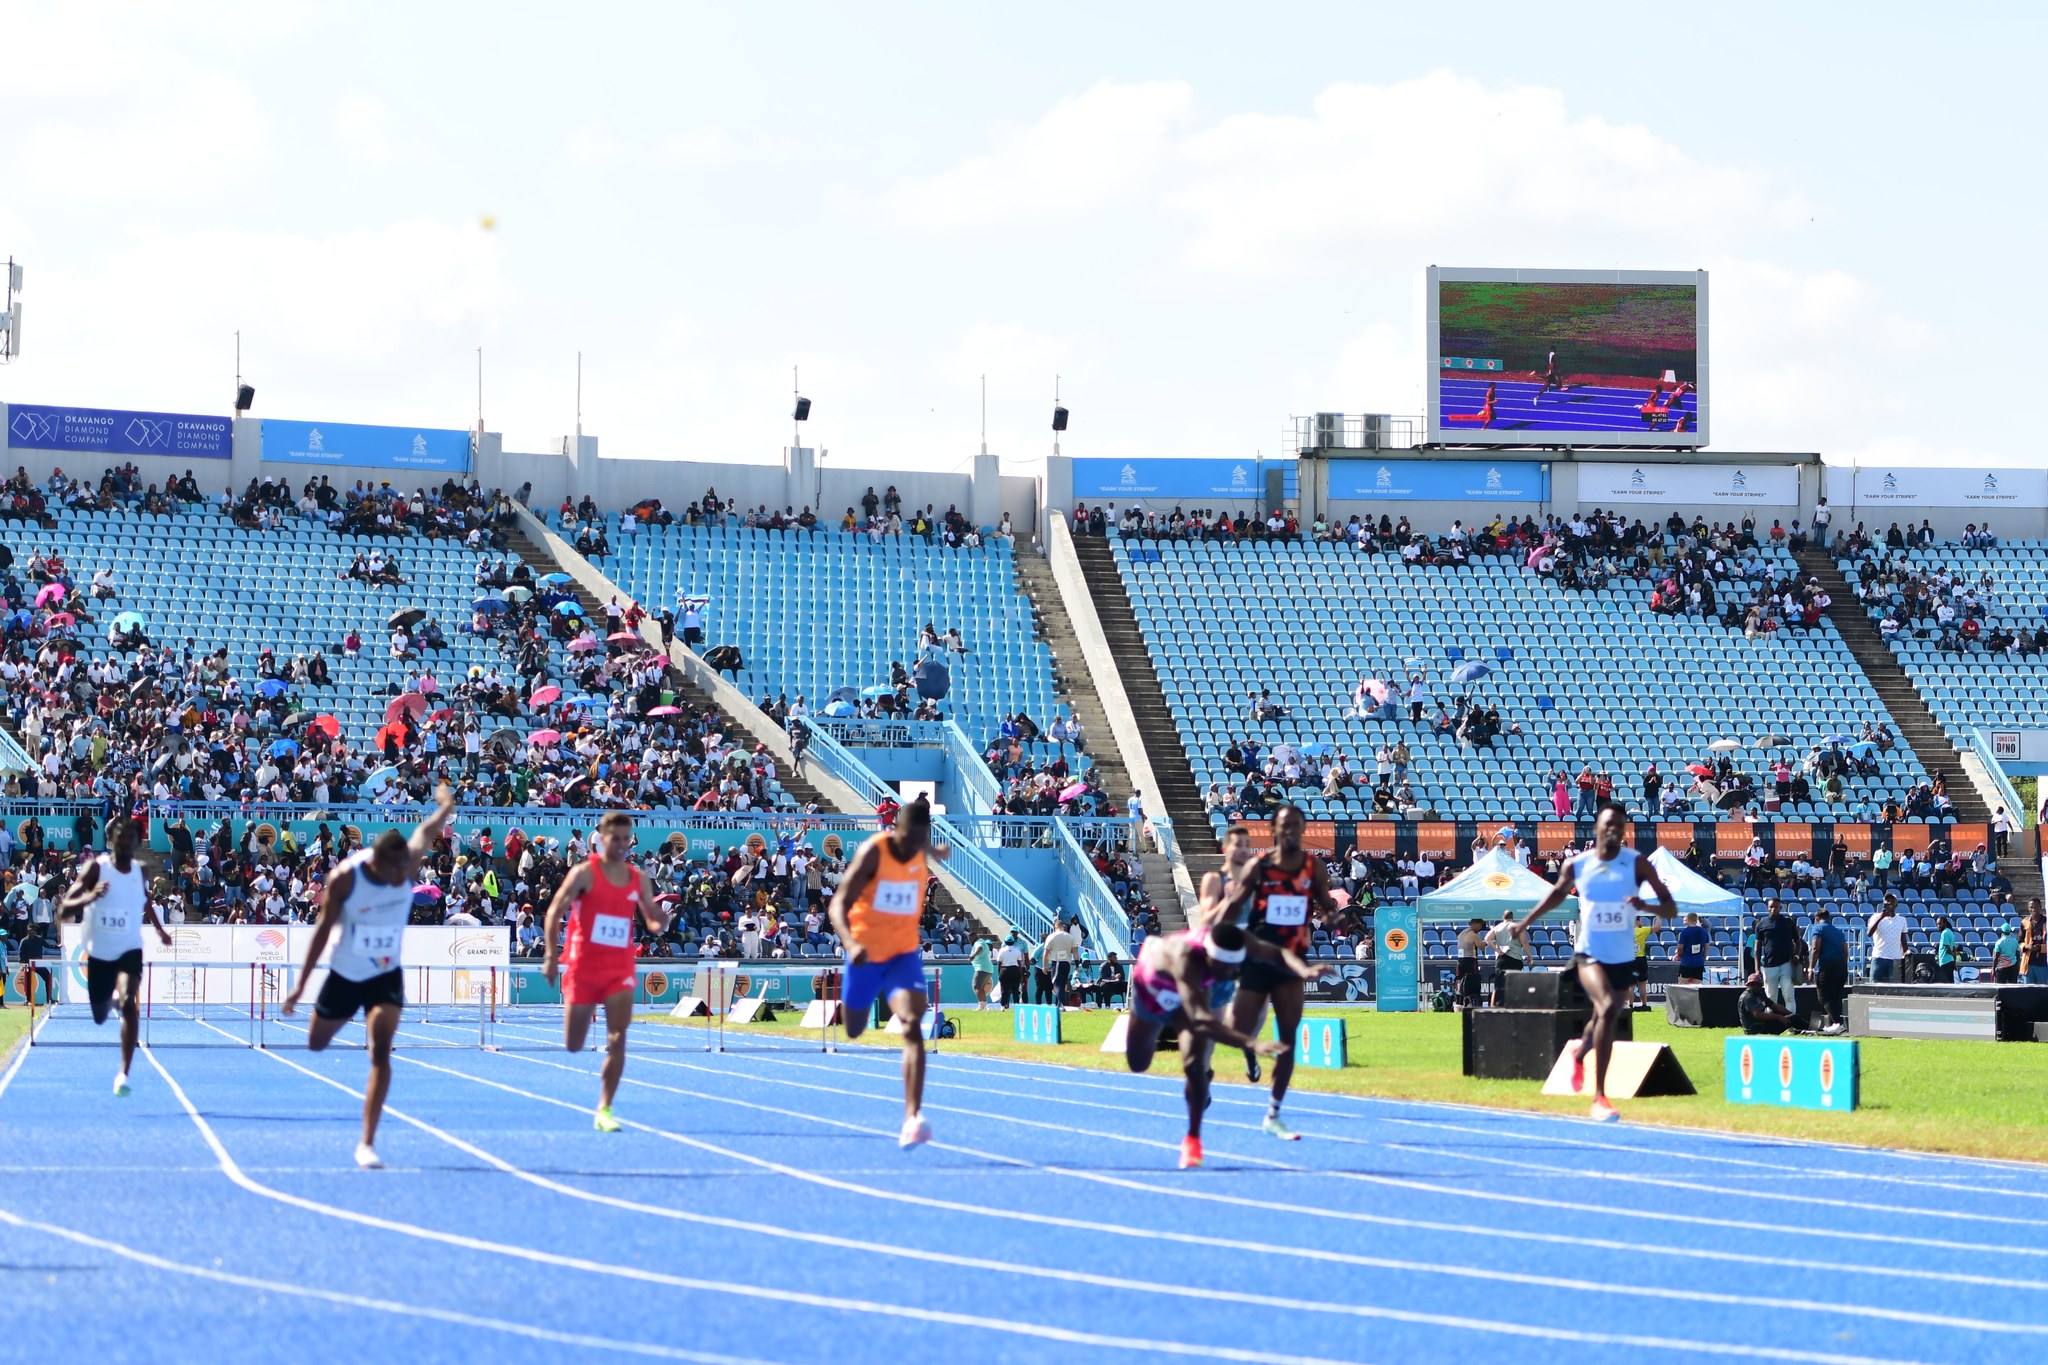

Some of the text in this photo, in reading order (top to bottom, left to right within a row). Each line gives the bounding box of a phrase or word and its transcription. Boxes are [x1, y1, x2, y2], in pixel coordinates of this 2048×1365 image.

[65, 416, 114, 425] OKAVANGO
[65, 426, 109, 434] DIAMOND
[178, 422, 225, 432] OKAVANGO
[65, 436, 108, 444] COMPANY
[178, 432, 220, 440] DIAMOND
[178, 442, 220, 450] COMPANY
[47, 828, 72, 838] FNB
[692, 839, 715, 850] FNB
[886, 893, 911, 906] 131
[1274, 905, 1301, 917] 135
[101, 916, 126, 927] 130
[1596, 912, 1623, 924] 136
[600, 925, 625, 939] 133
[363, 936, 394, 949] 132
